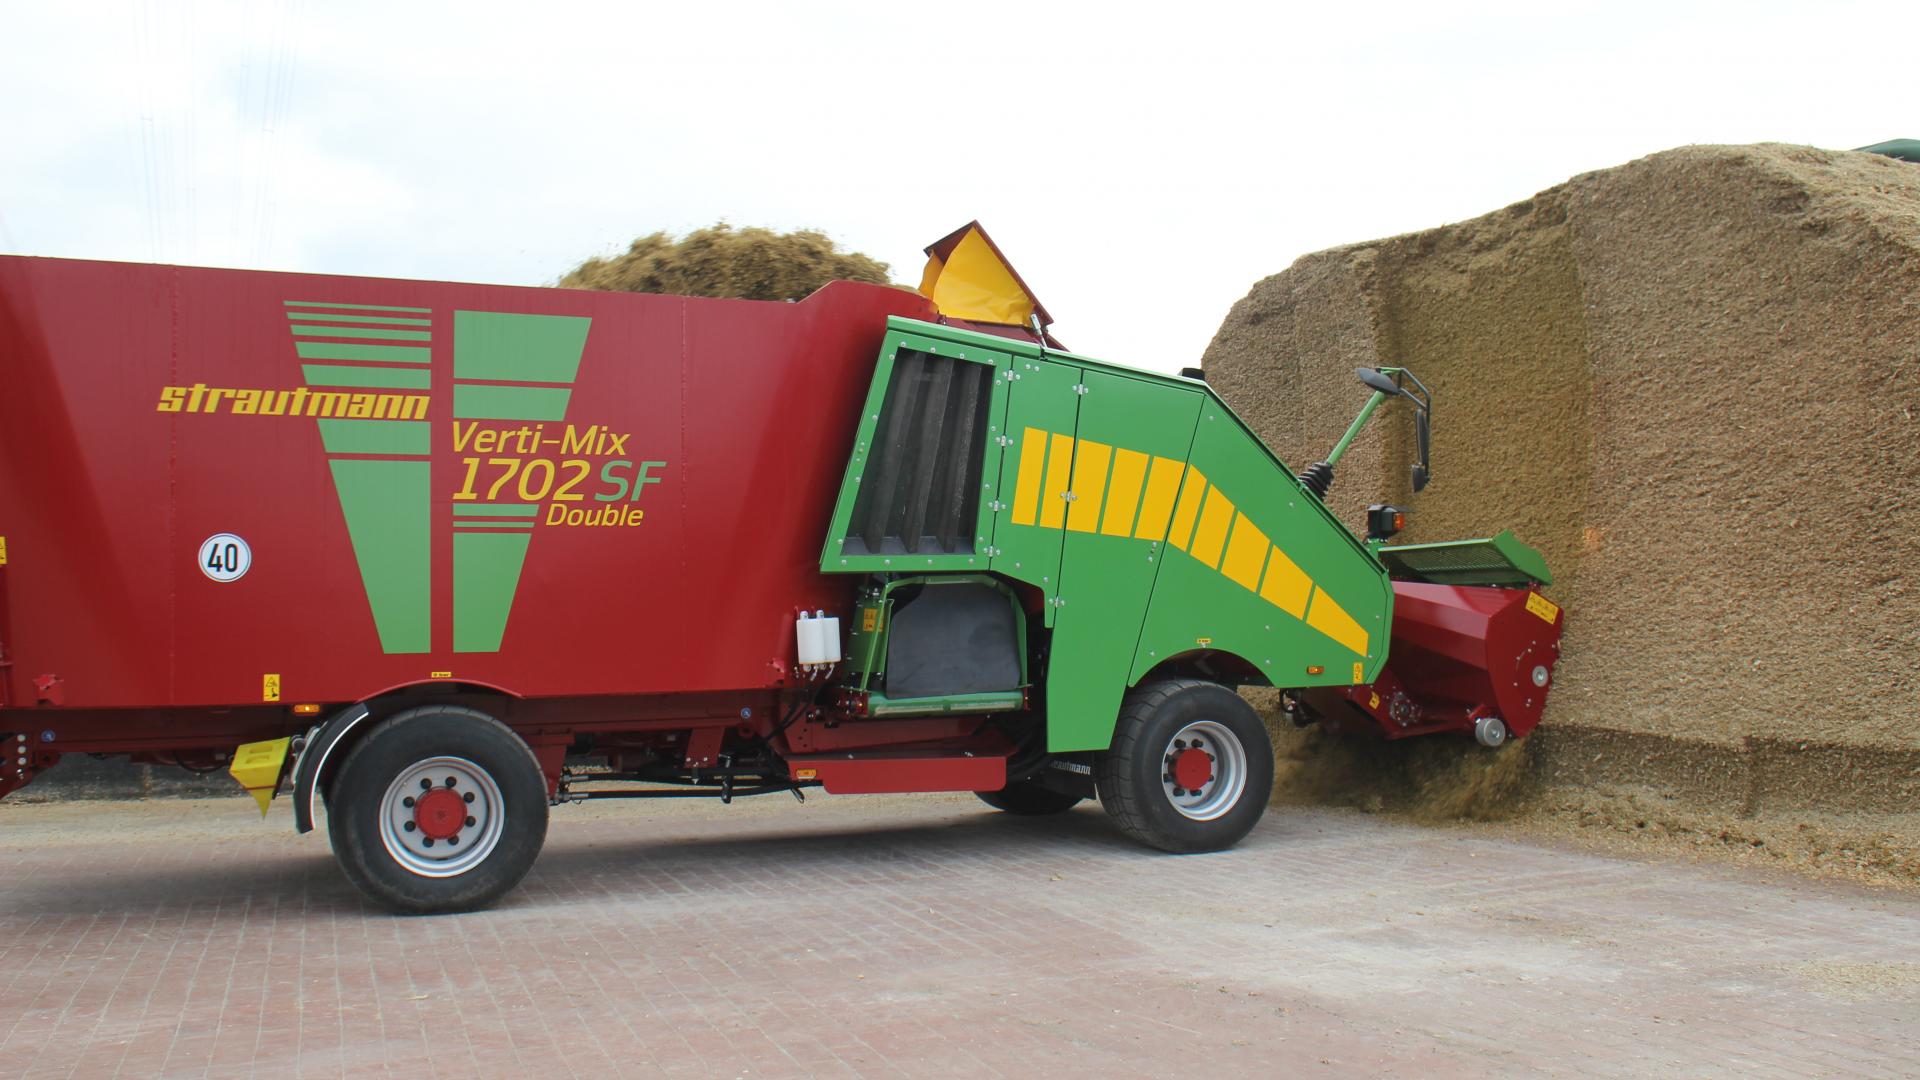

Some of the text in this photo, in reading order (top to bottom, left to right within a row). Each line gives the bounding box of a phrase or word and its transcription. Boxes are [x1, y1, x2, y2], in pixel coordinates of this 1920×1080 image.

[156, 383, 431, 420] strautmann
[452, 421, 631, 456] Verti-Mix
[452, 457, 667, 502] 1702 SF
[545, 503, 644, 527] Double
[207, 543, 238, 573] 40
